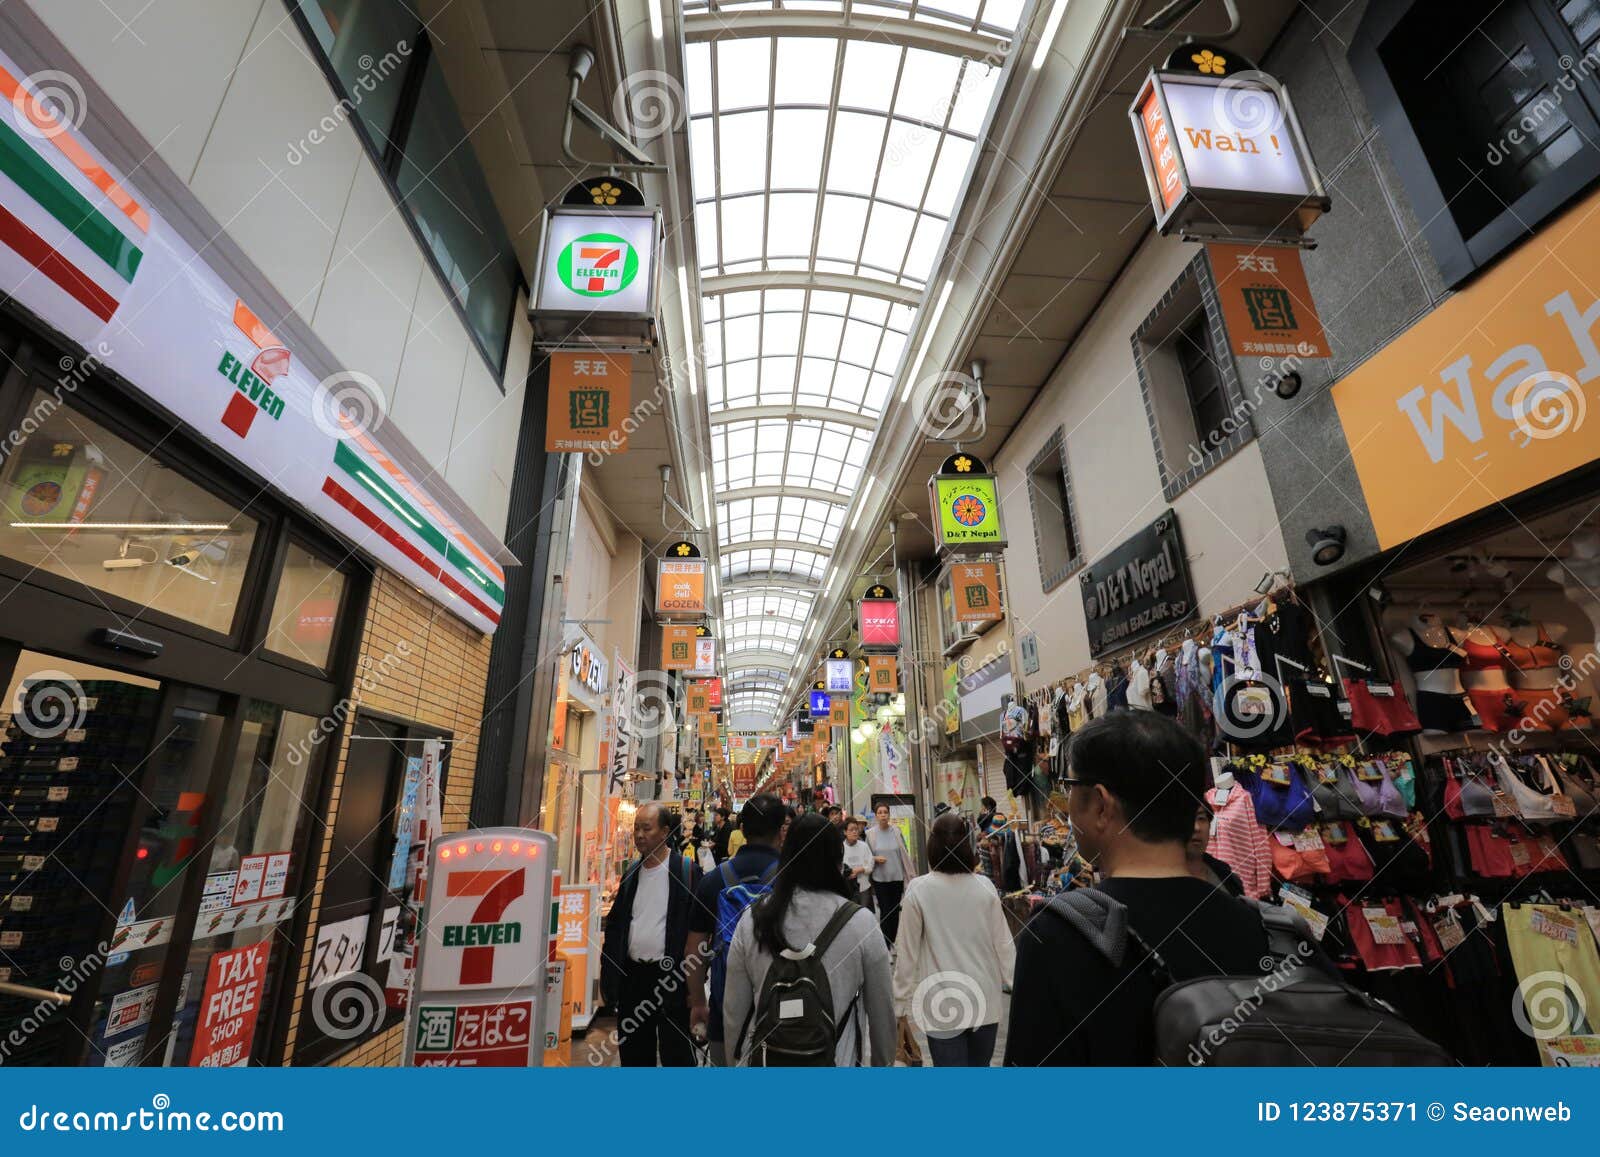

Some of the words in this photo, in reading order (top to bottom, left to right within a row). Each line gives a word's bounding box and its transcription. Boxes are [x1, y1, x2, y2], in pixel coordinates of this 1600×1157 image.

[1184, 127, 1260, 155] Wah
[576, 267, 619, 278] ELEVEN
[1236, 254, 1278, 273] 天五
[573, 360, 608, 376] 天五
[217, 351, 286, 420] ELEVEN
[970, 529, 997, 538] Nepal
[1096, 567, 1130, 617] D&T
[1128, 540, 1175, 599] Nepal
[663, 600, 700, 608] GOZEN
[1102, 620, 1130, 646] ASIAN
[1129, 601, 1171, 632] BAZAR
[443, 922, 521, 947] ELEVEN
[217, 947, 263, 988] TAX-
[205, 980, 258, 1028] FREE
[210, 1017, 244, 1046] SHOP
[419, 1010, 454, 1049] 酒
[457, 1006, 527, 1048] たばこ
